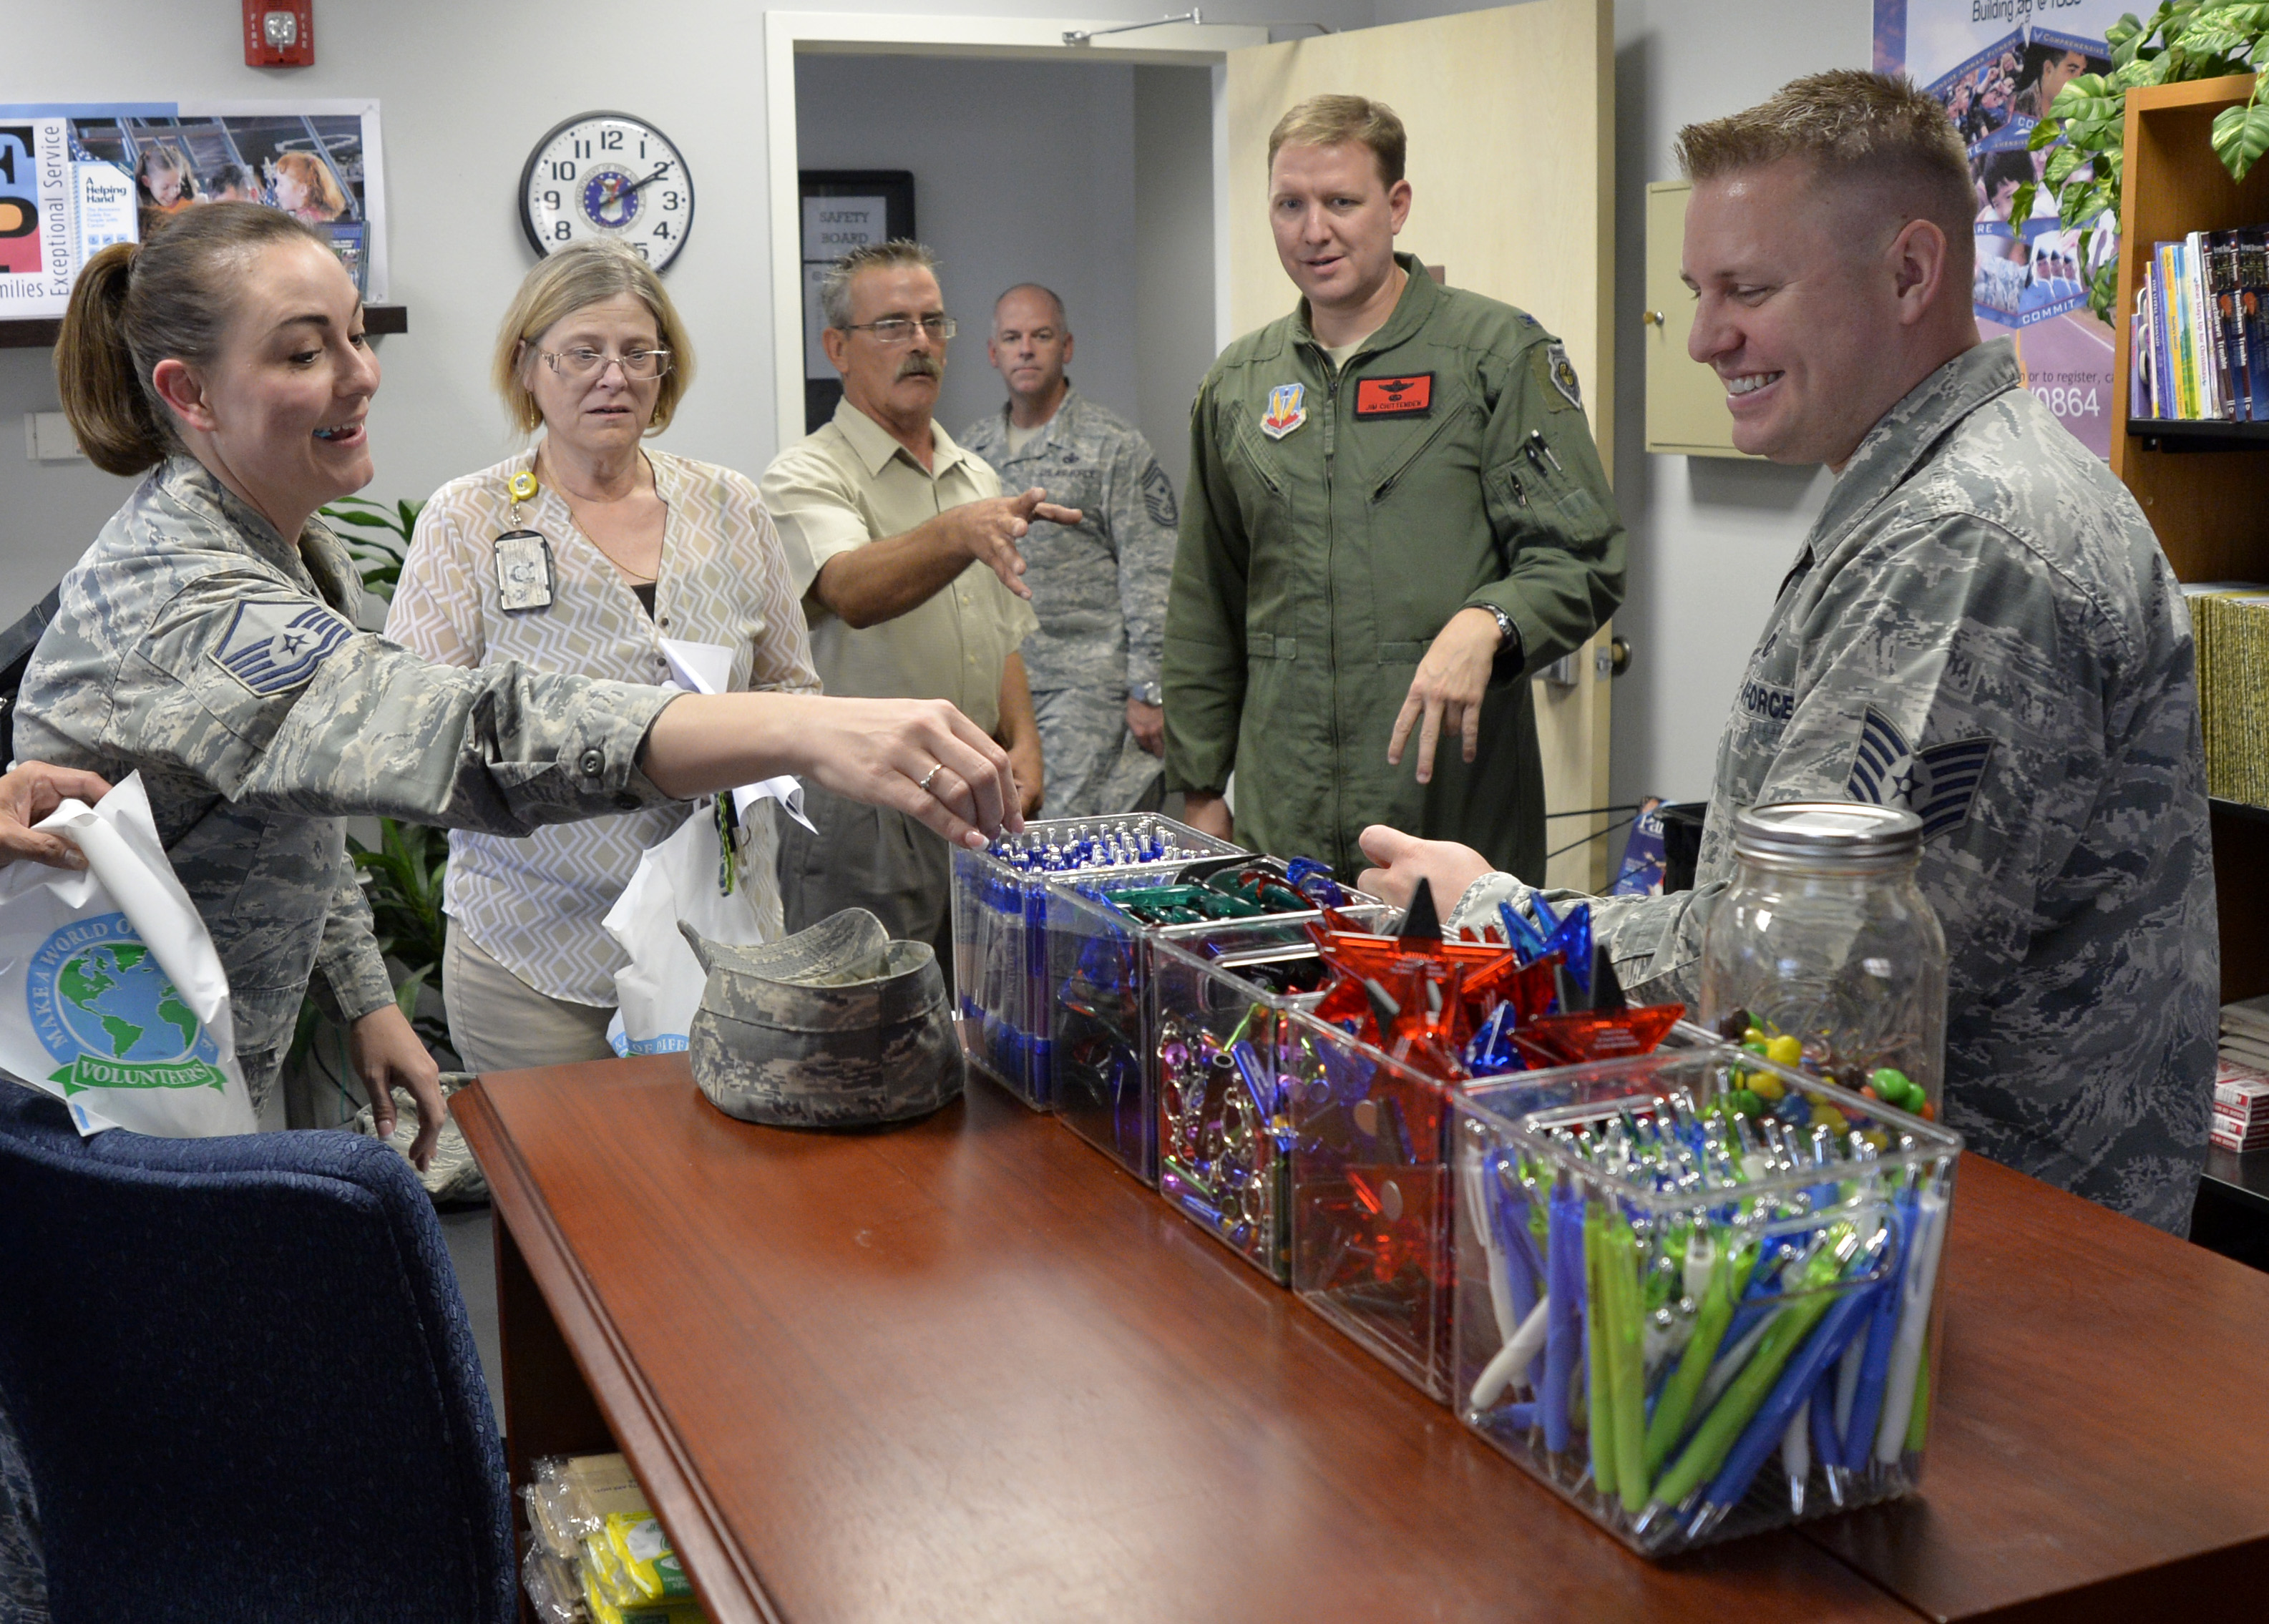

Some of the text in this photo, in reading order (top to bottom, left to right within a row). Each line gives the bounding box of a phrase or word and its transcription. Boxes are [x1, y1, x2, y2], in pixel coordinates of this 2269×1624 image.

[1973, 0, 2014, 22] Building
[575, 140, 590, 159] 11
[601, 130, 623, 150] 12
[640, 140, 645, 159] 1
[552, 161, 575, 181] 10
[653, 161, 669, 181] 2
[86, 185, 127, 196] Helping
[87, 195, 114, 203] Hand
[544, 190, 560, 210] 9
[662, 191, 678, 210] 3
[41, 126, 69, 296] Exceptional Service
[819, 211, 870, 223] SAFETY
[555, 220, 572, 240] 8
[652, 221, 670, 240] 4
[821, 233, 869, 244] BOARD
[2022, 299, 2075, 325] COMMIT
[2234, 288, 2244, 334] Touchdown
[2210, 292, 2222, 338] Touchdown
[2217, 340, 2227, 370] Trouble
[2238, 336, 2248, 366] Trouble
[2029, 373, 2039, 383] or
[2043, 371, 2054, 383] to
[2056, 371, 2101, 386] register,
[1740, 680, 1795, 719] FORCE
[41, 922, 108, 967] WORLD
[34, 969, 50, 984] A
[32, 987, 68, 1050] MAKE
[633, 1043, 653, 1054] OF
[79, 1060, 208, 1085] VOLUNTEERS
